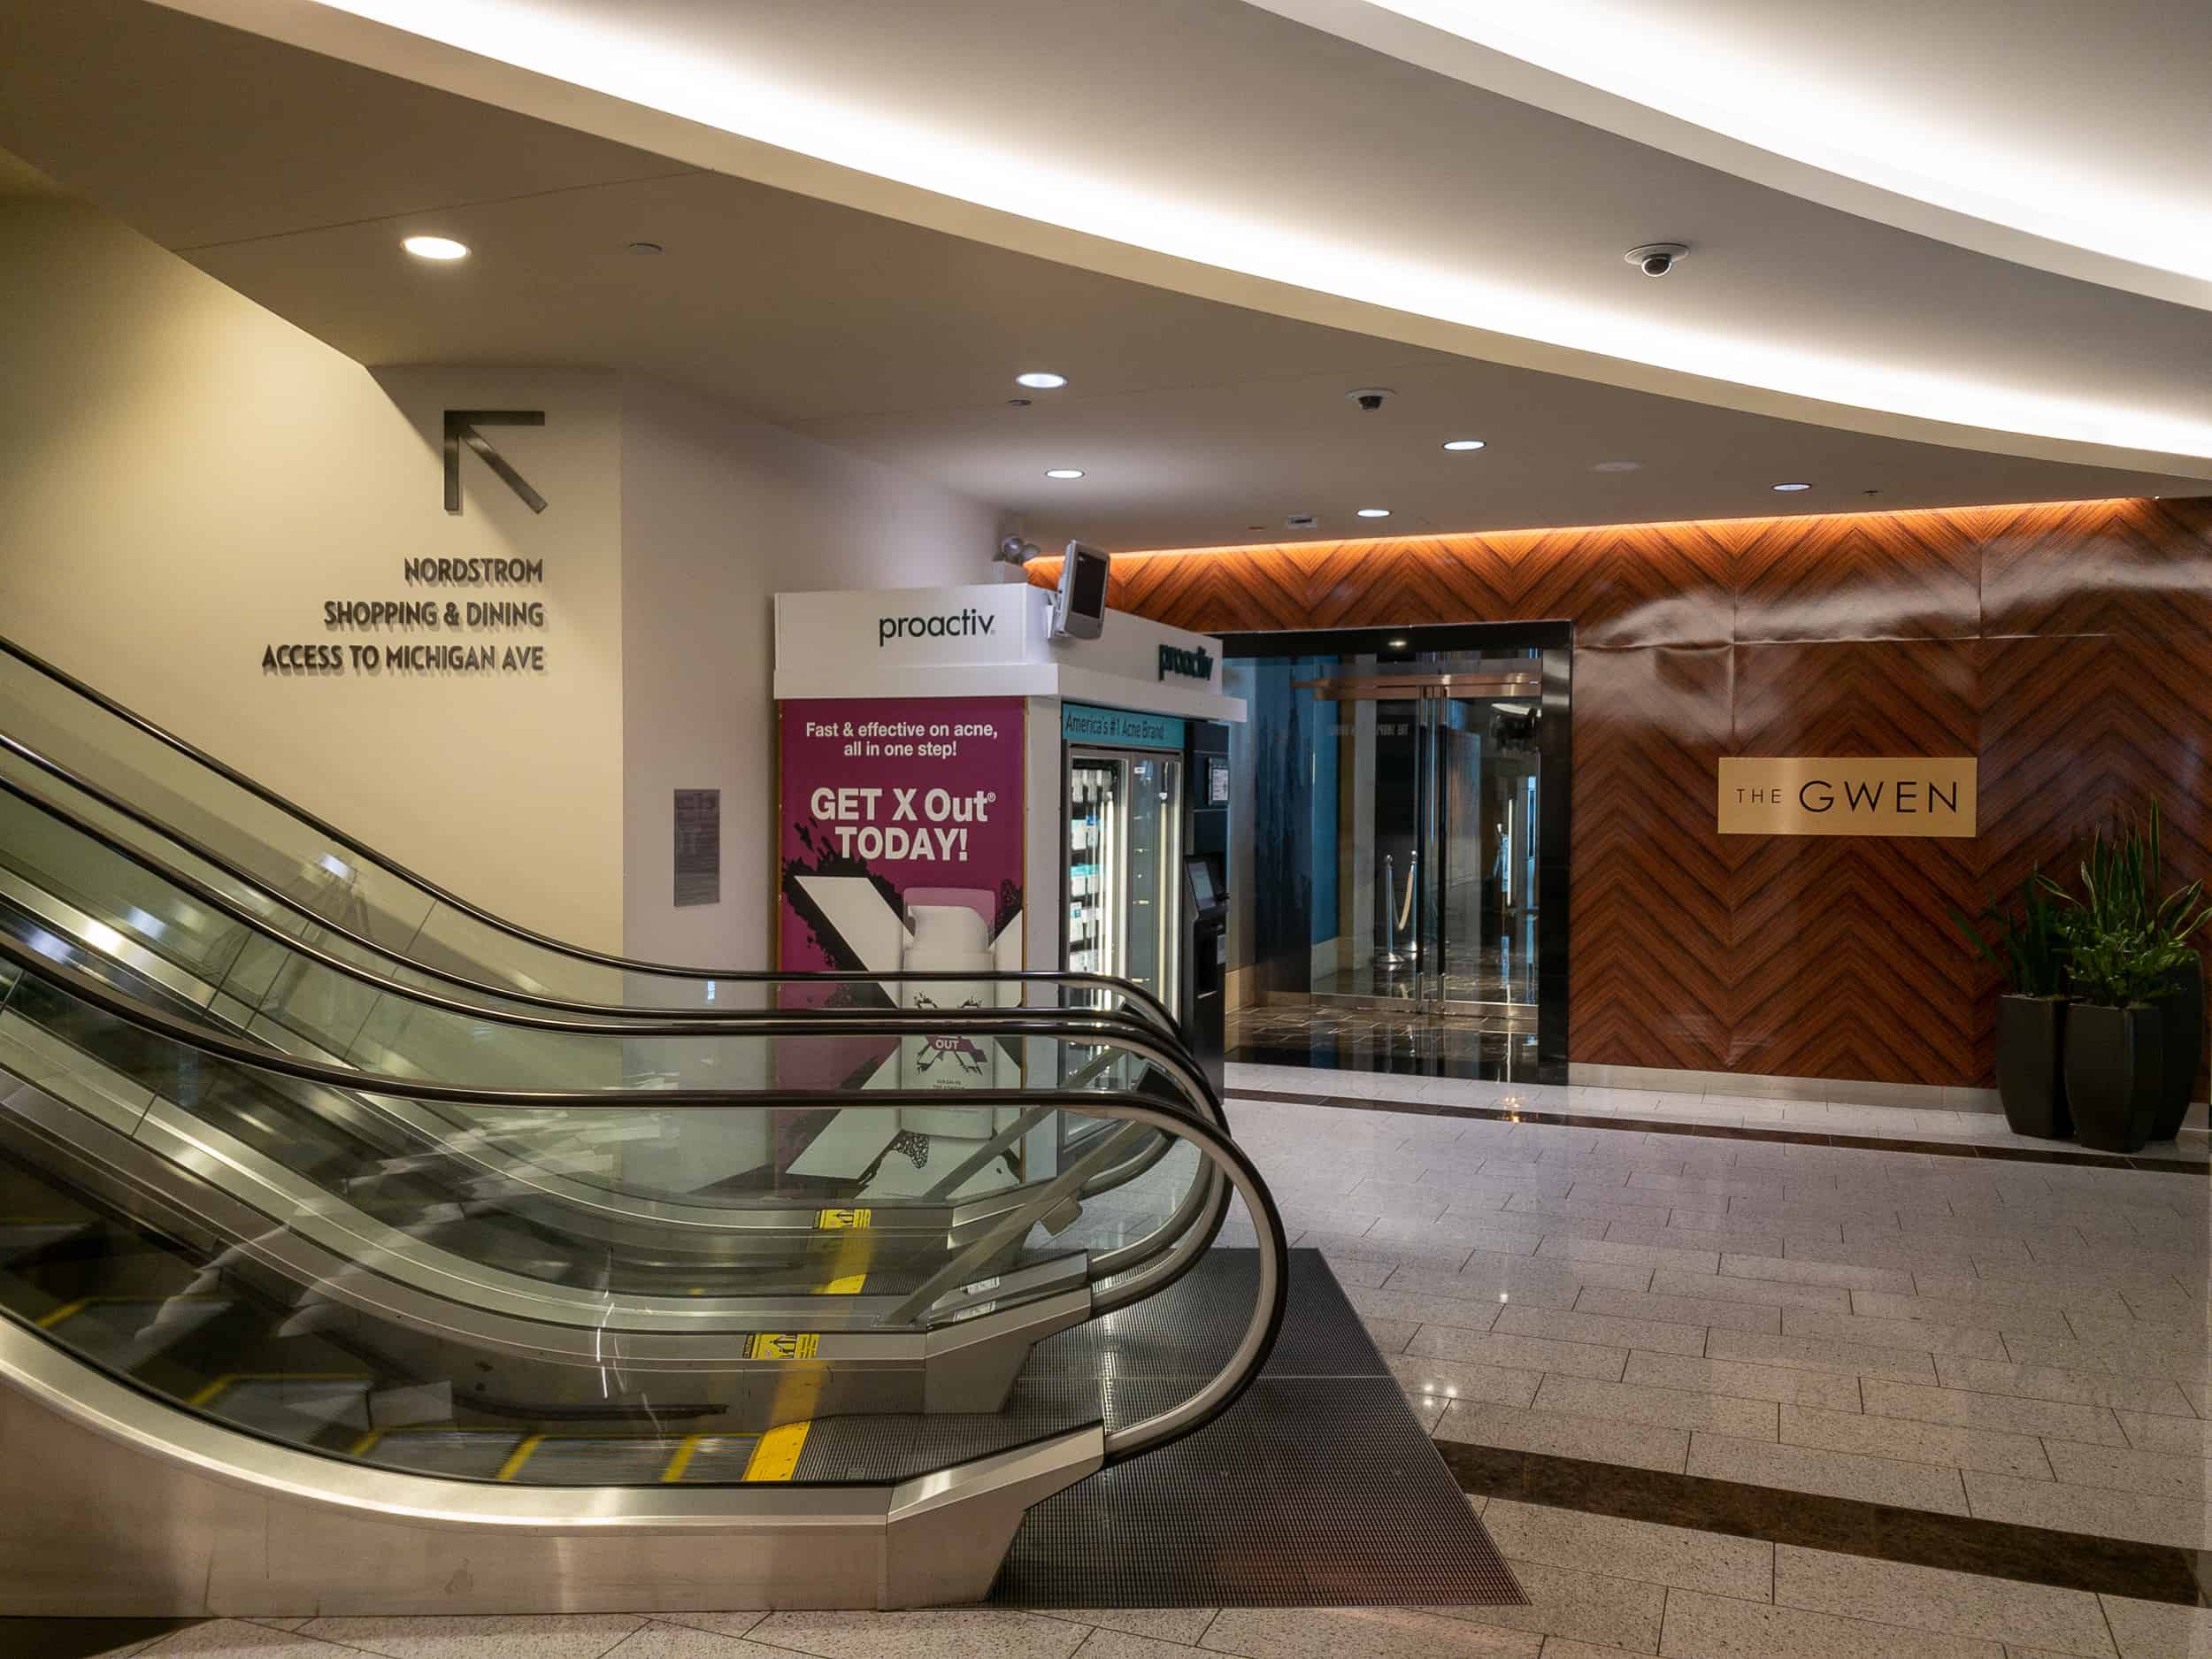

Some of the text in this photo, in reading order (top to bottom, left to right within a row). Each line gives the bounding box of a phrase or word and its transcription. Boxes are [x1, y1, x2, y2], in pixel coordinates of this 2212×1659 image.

[403, 557, 544, 583] NORDSTROM
[323, 601, 544, 627] SHOPPING & DINING
[878, 608, 995, 648] proactiv
[261, 644, 545, 672] ACCESS TO MICHIGAN AVE
[805, 721, 998, 740] Fast & effective on acne,
[1065, 710, 1109, 736] America's
[1121, 718, 1141, 738] Acne
[1142, 719, 1165, 741] Brand
[843, 741, 957, 760] all in one step!
[810, 787, 883, 821] GET
[891, 787, 918, 821] X
[1736, 780, 1958, 814] THE GWEN
[834, 826, 969, 862] TODAY!
[935, 1040, 959, 1050] OUT
